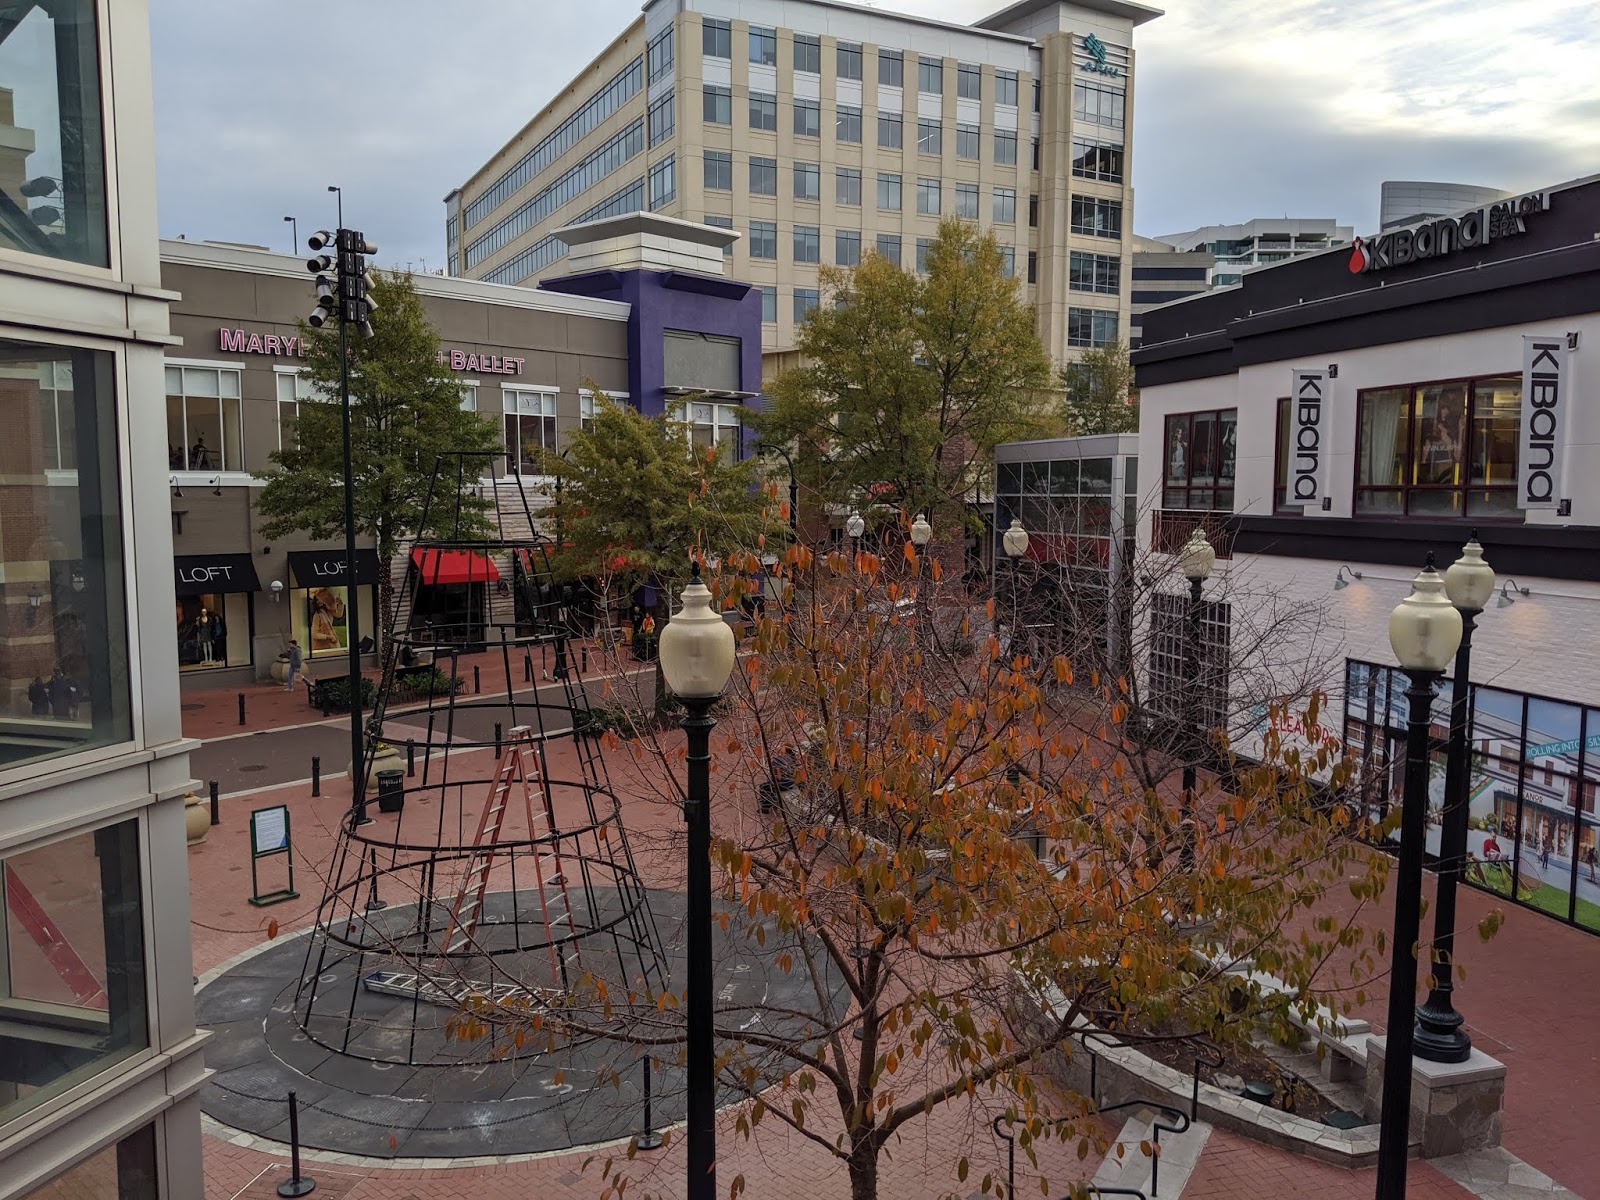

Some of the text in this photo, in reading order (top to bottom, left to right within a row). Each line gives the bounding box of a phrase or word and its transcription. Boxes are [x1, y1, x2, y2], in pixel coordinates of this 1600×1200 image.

[1490, 193, 1549, 222] SALON
[1490, 216, 1525, 239] SPA
[220, 327, 308, 357] MARYL
[451, 349, 525, 374] BALLET
[179, 566, 233, 583] LOFT
[1526, 743, 1560, 757] ROLLING
[1561, 740, 1580, 752] INTO
[1514, 787, 1543, 804] EANOR
